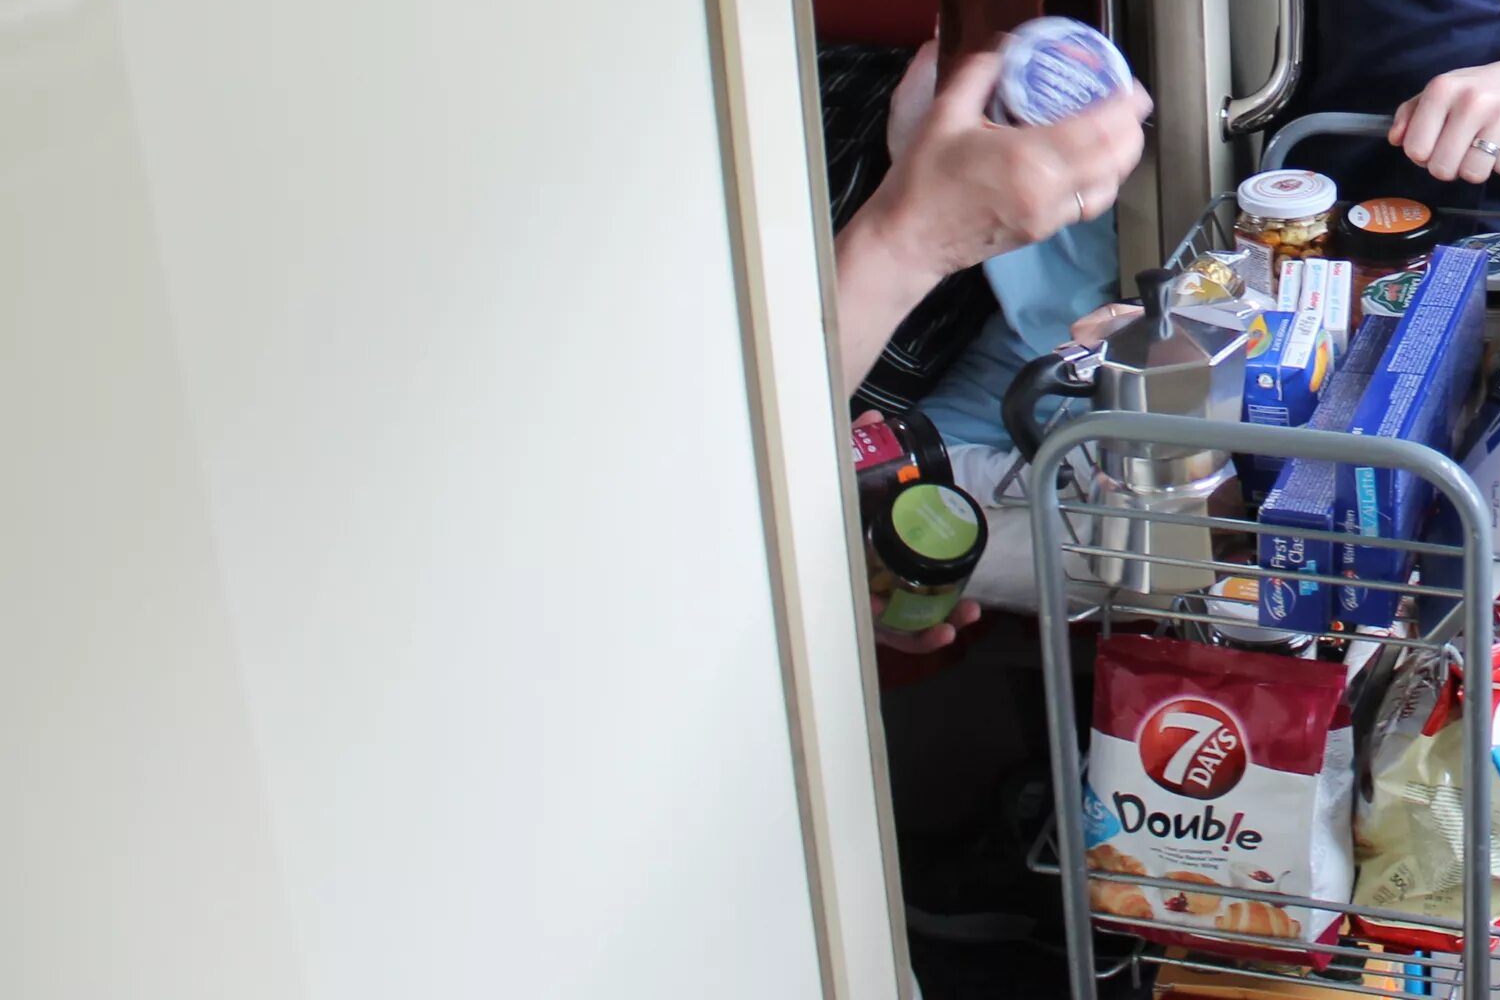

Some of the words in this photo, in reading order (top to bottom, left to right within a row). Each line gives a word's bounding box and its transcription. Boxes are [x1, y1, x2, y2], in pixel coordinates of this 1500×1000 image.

[1269, 537, 1288, 569] First
[1287, 536, 1305, 563] Clas
[1158, 711, 1224, 786] 7
[1188, 727, 1238, 789] DAYS
